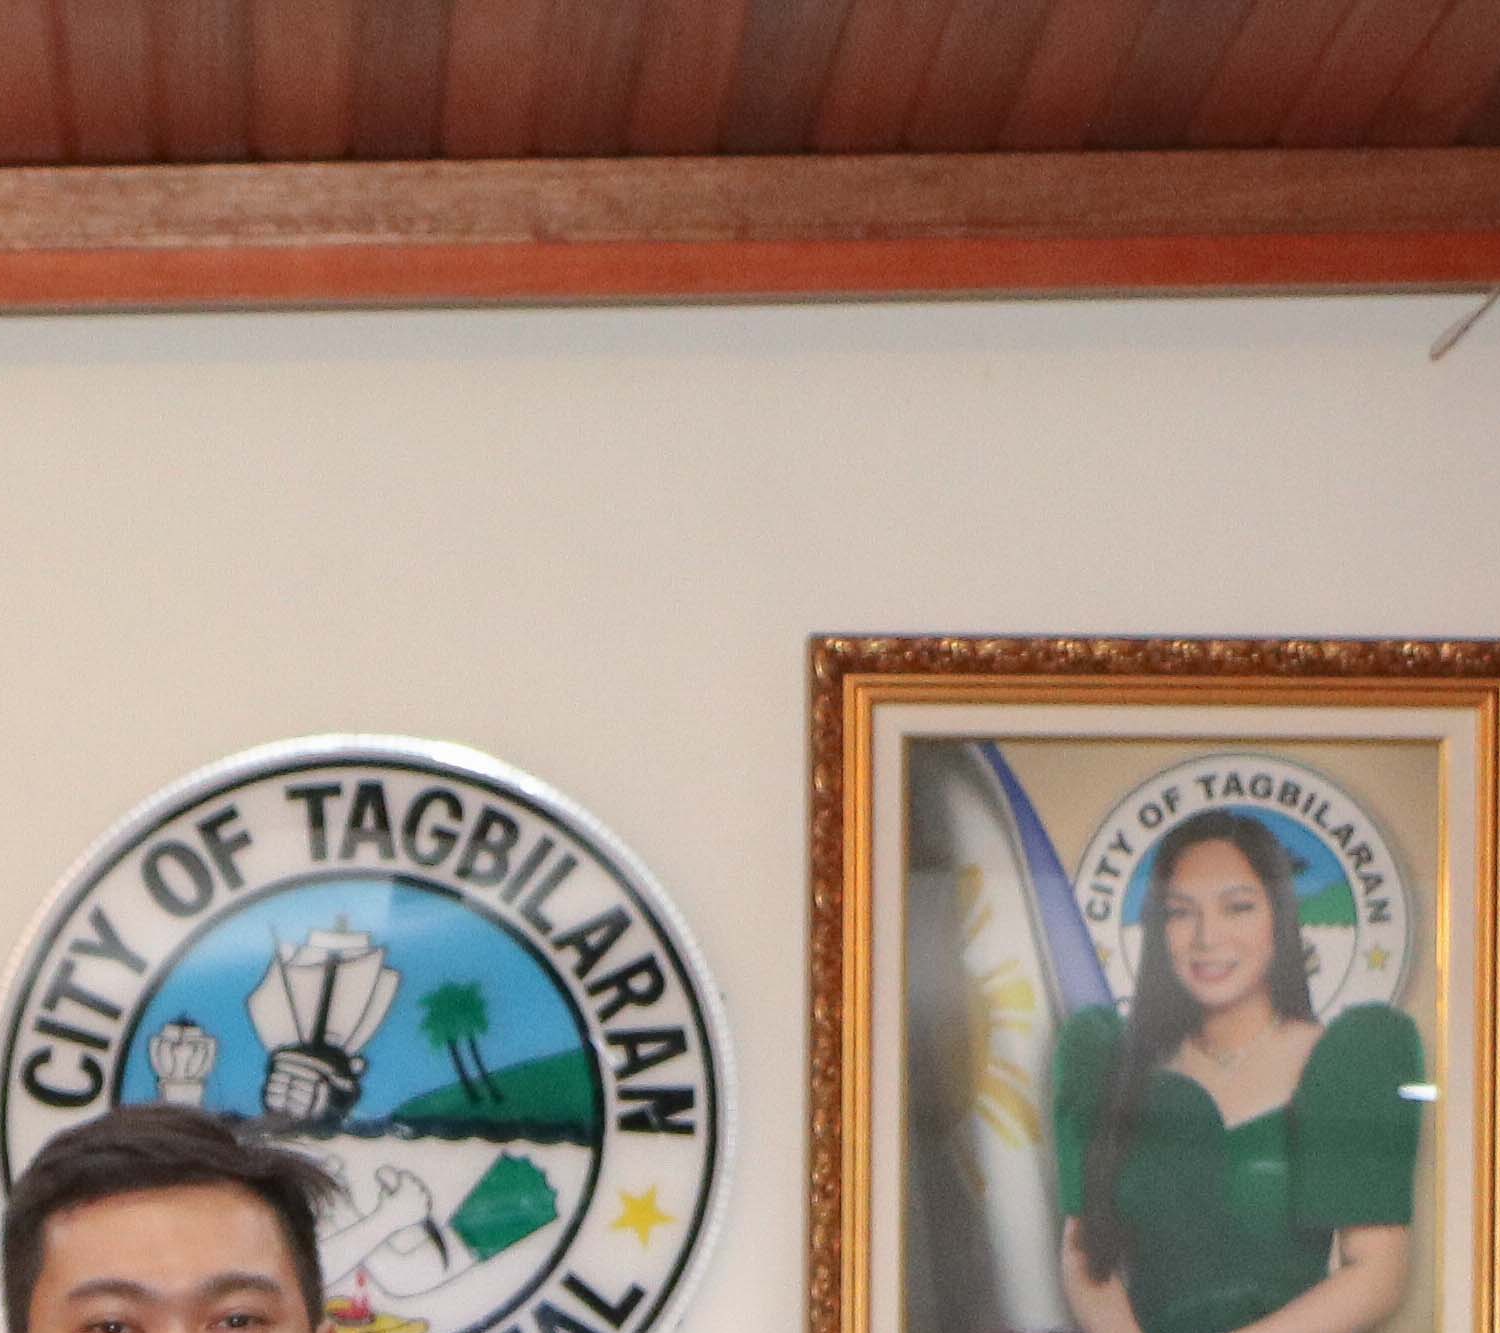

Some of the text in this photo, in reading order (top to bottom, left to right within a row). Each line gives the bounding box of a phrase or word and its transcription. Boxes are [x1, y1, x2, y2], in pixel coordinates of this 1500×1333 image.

[21, 780, 697, 1138] CITY OF TAGBILARAN
[1086, 771, 1392, 926] CITY OF TAGBILARAN
